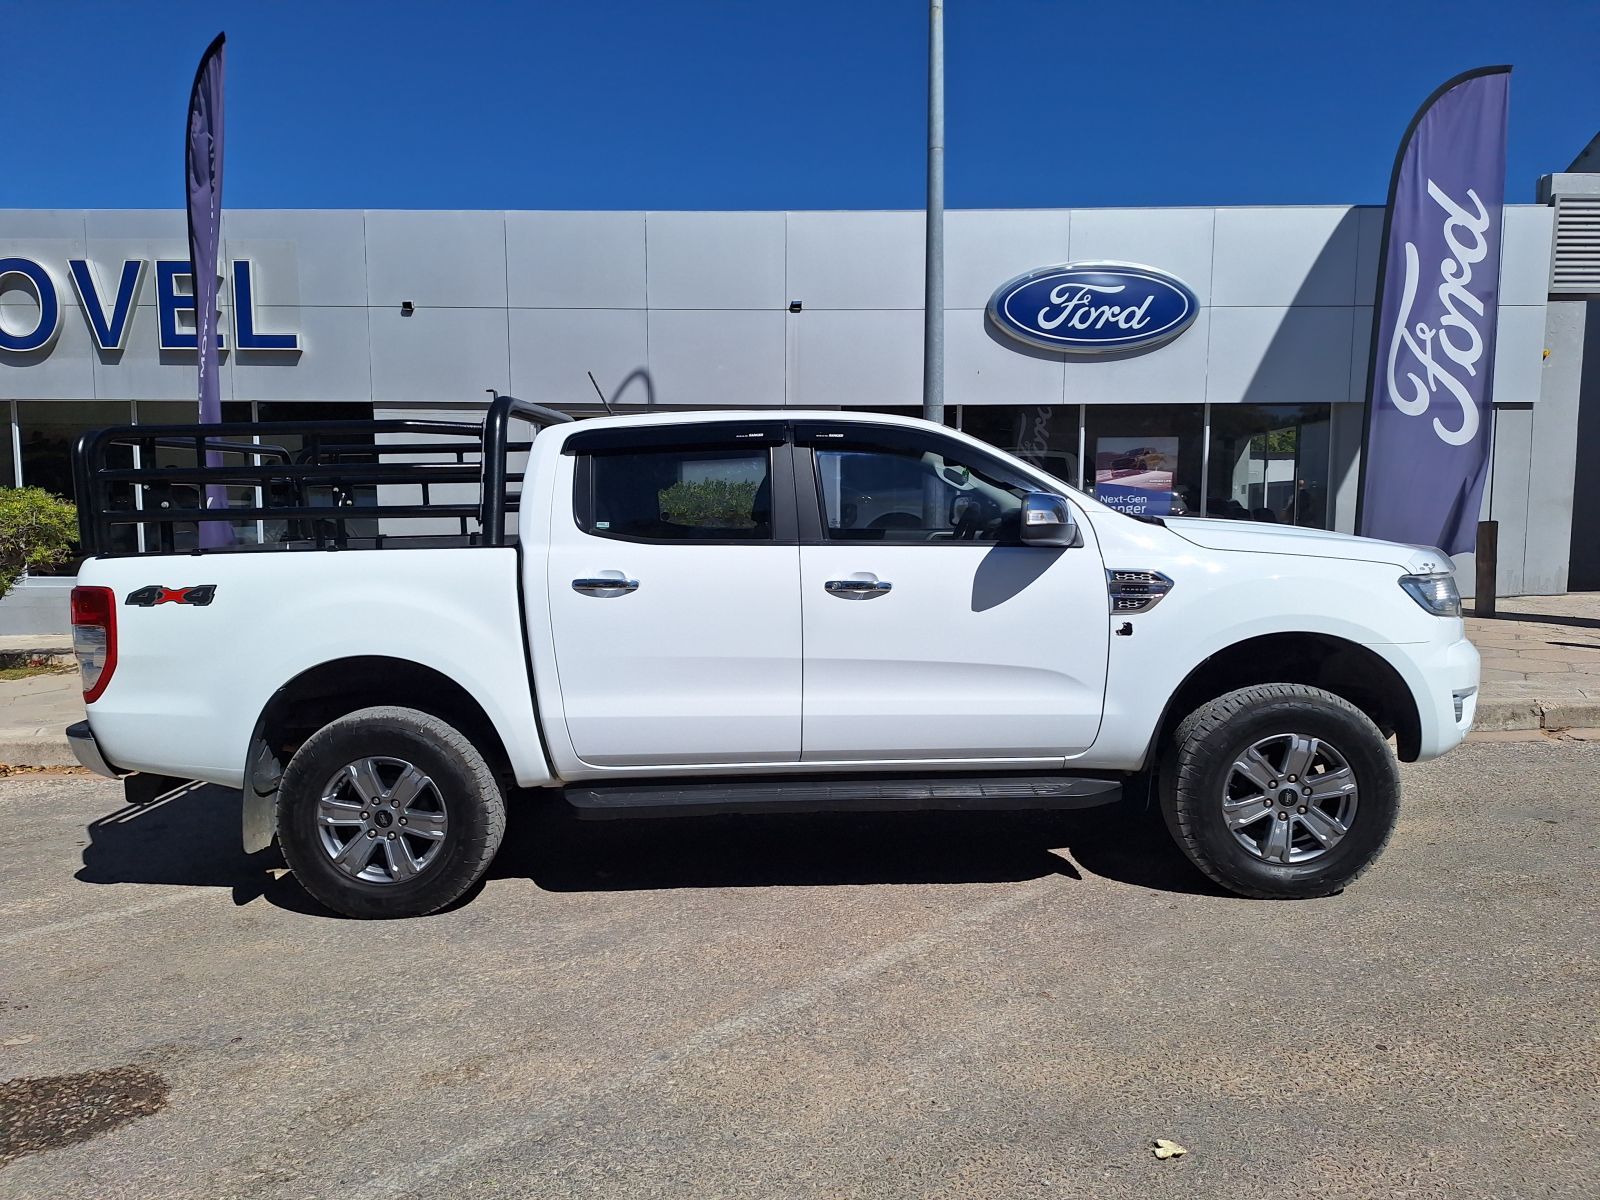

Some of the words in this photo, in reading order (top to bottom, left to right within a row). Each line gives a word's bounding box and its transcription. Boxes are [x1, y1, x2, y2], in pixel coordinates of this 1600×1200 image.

[0, 256, 301, 351] OVEL
[1037, 282, 1155, 330] Ford
[1386, 178, 1490, 446] Ford
[1100, 494, 1148, 504] Next-Gen
